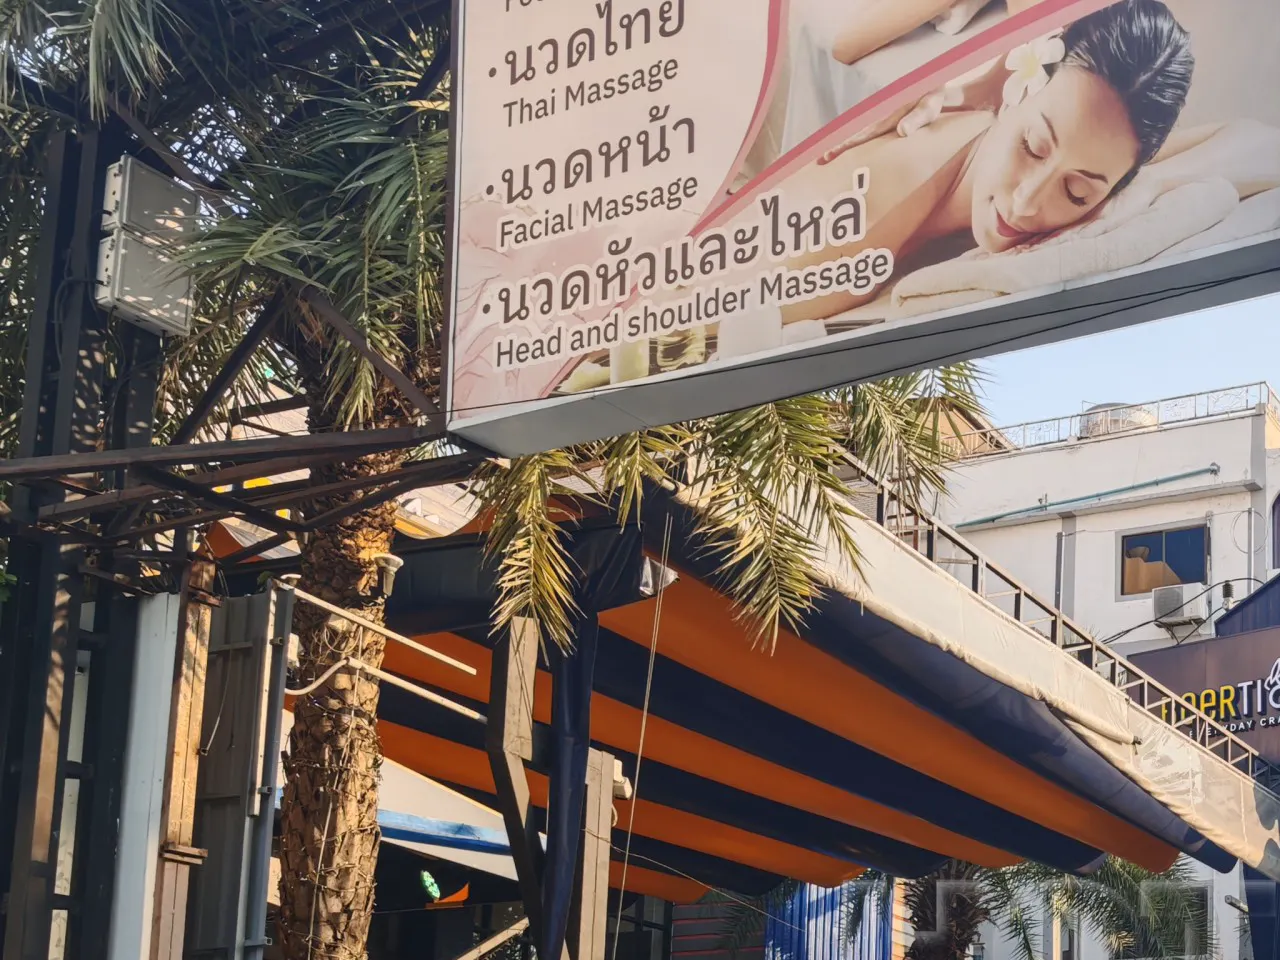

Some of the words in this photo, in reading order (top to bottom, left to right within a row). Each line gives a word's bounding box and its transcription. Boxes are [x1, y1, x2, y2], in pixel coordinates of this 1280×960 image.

[504, 0, 686, 86] นวดไทย
[503, 91, 557, 128] Thai
[564, 57, 679, 112] Massage
[501, 105, 696, 204] นวดหน้า
[497, 173, 867, 325] นวดหัวและไหล่
[499, 210, 574, 248] Facial
[582, 176, 699, 228] Massage
[496, 328, 562, 368] Head
[569, 312, 620, 352] and
[627, 285, 752, 338] shoulder
[760, 250, 889, 306] Massage
